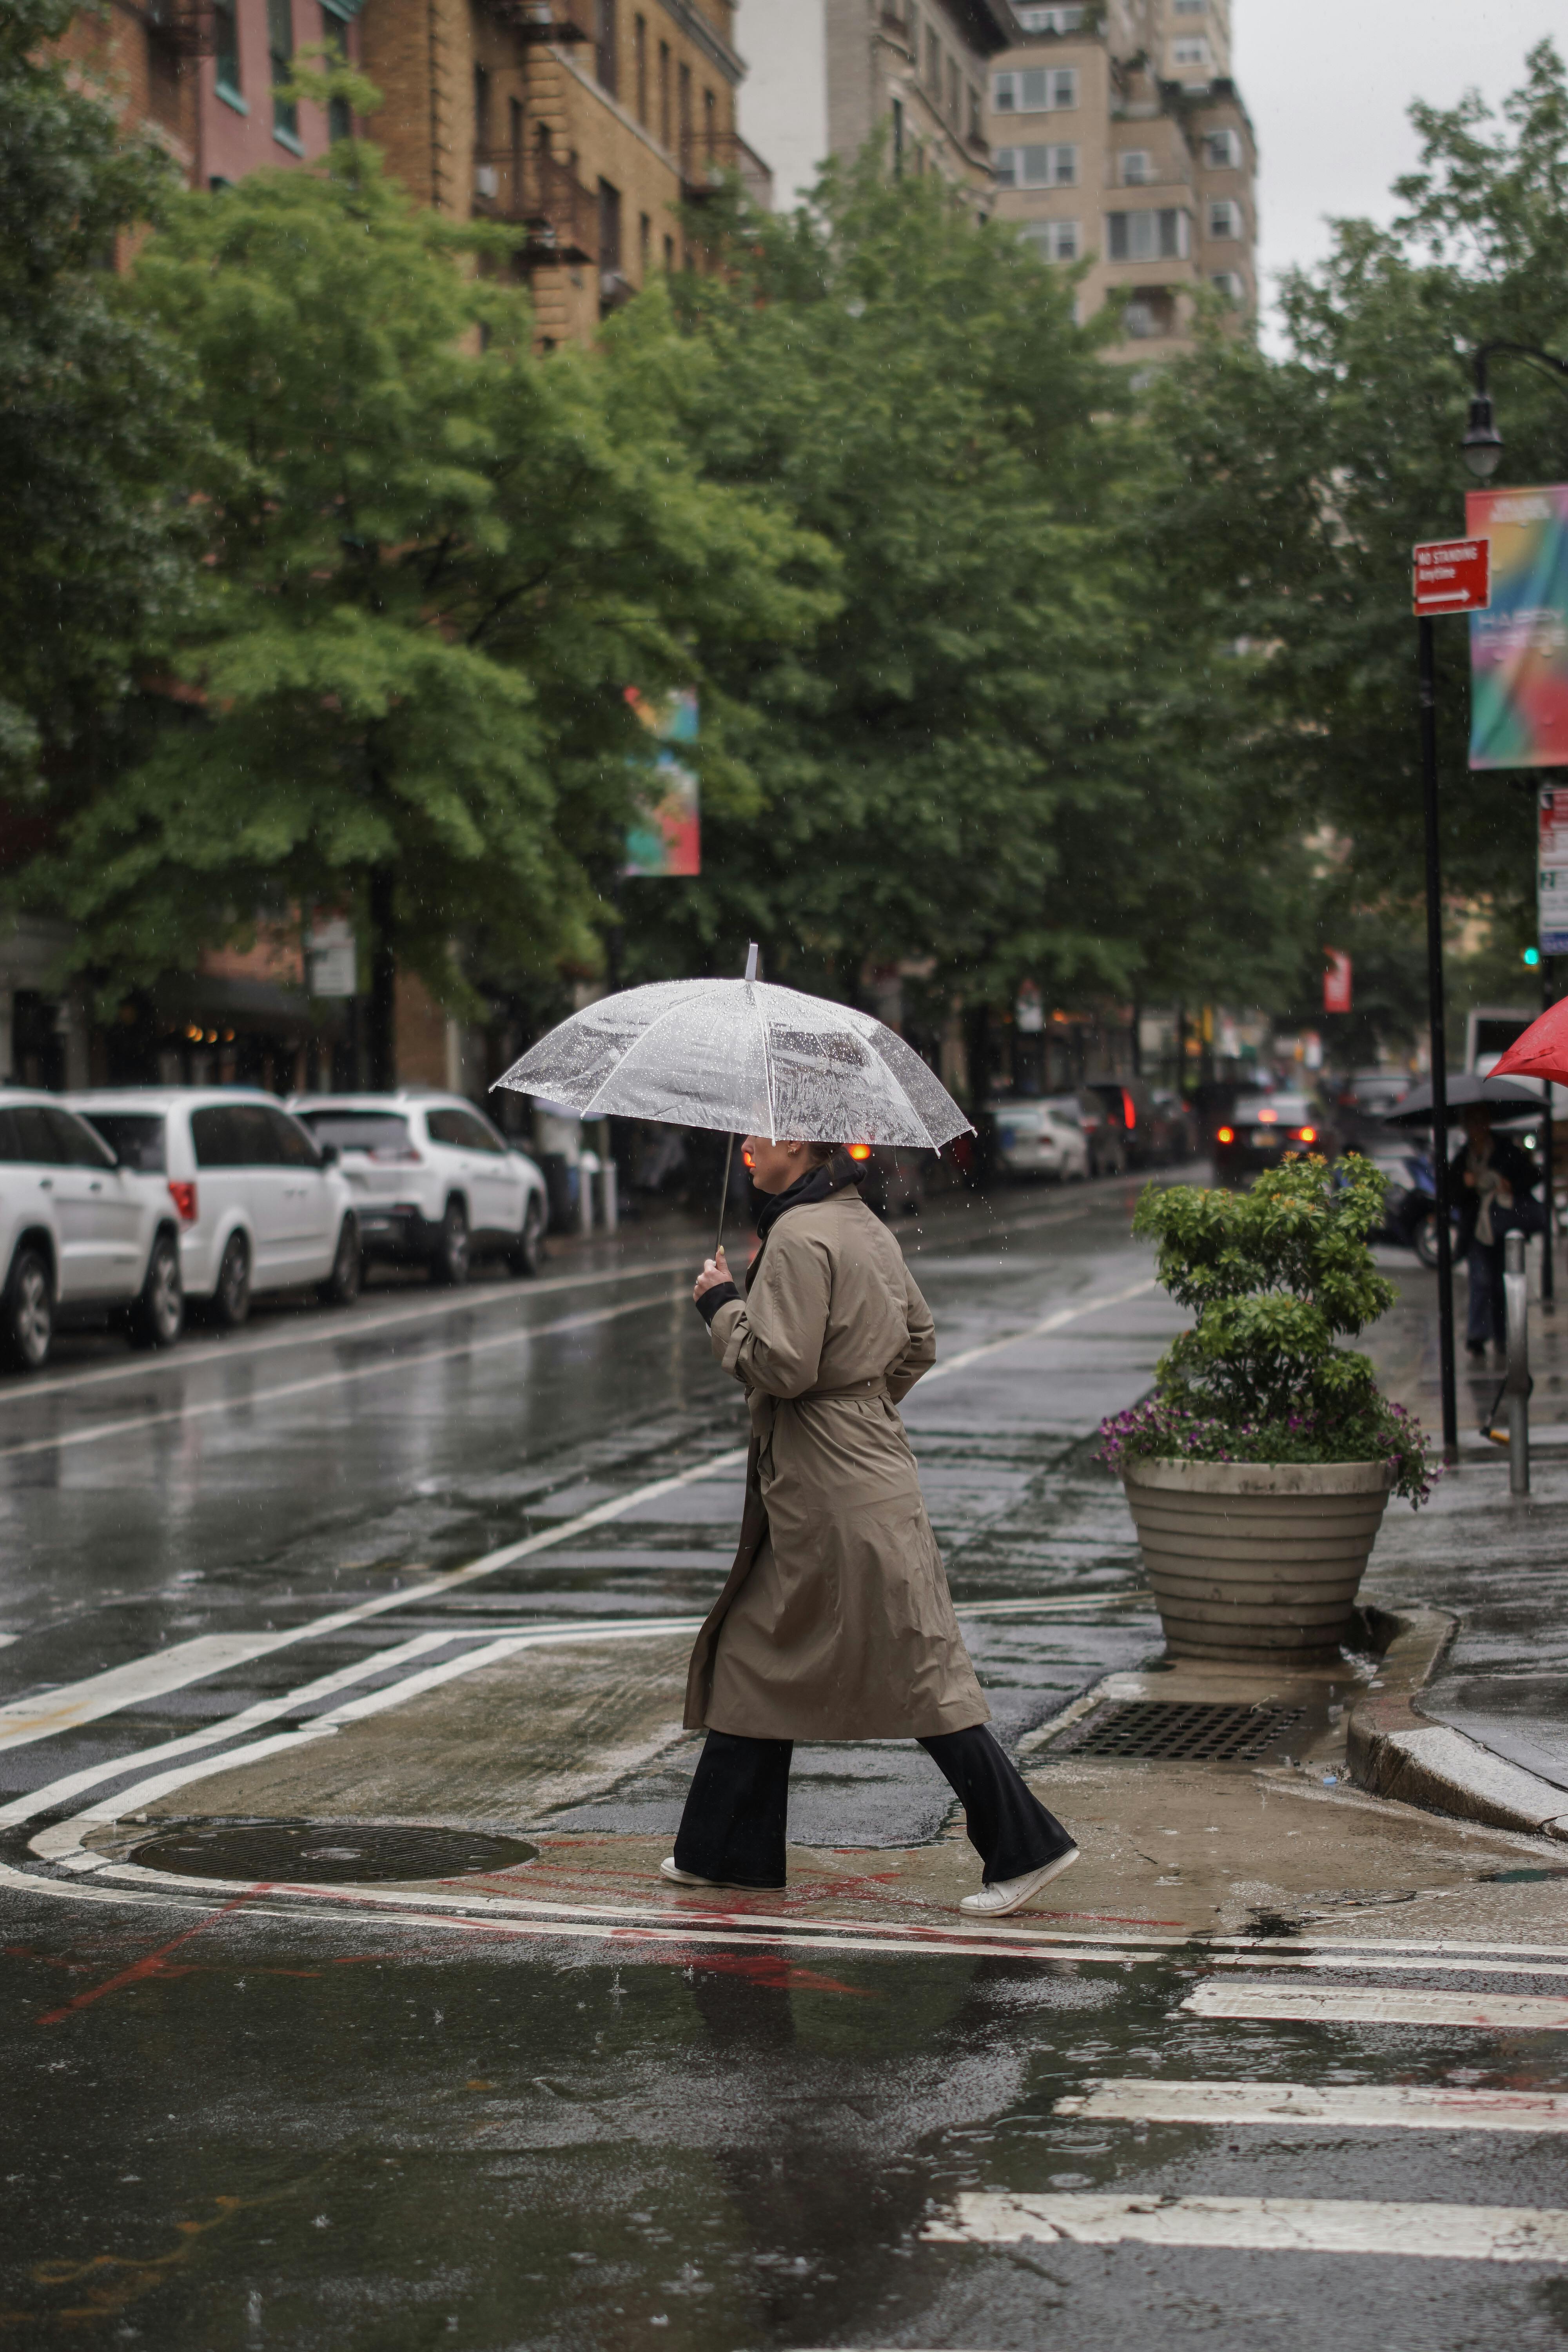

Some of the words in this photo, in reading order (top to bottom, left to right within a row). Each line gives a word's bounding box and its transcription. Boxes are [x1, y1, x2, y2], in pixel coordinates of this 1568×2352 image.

[1418, 553, 1431, 565] NO
[1433, 548, 1477, 564] STANDING
[1481, 610, 1563, 626] HAPPY
[1481, 630, 1567, 647] PRIDE
